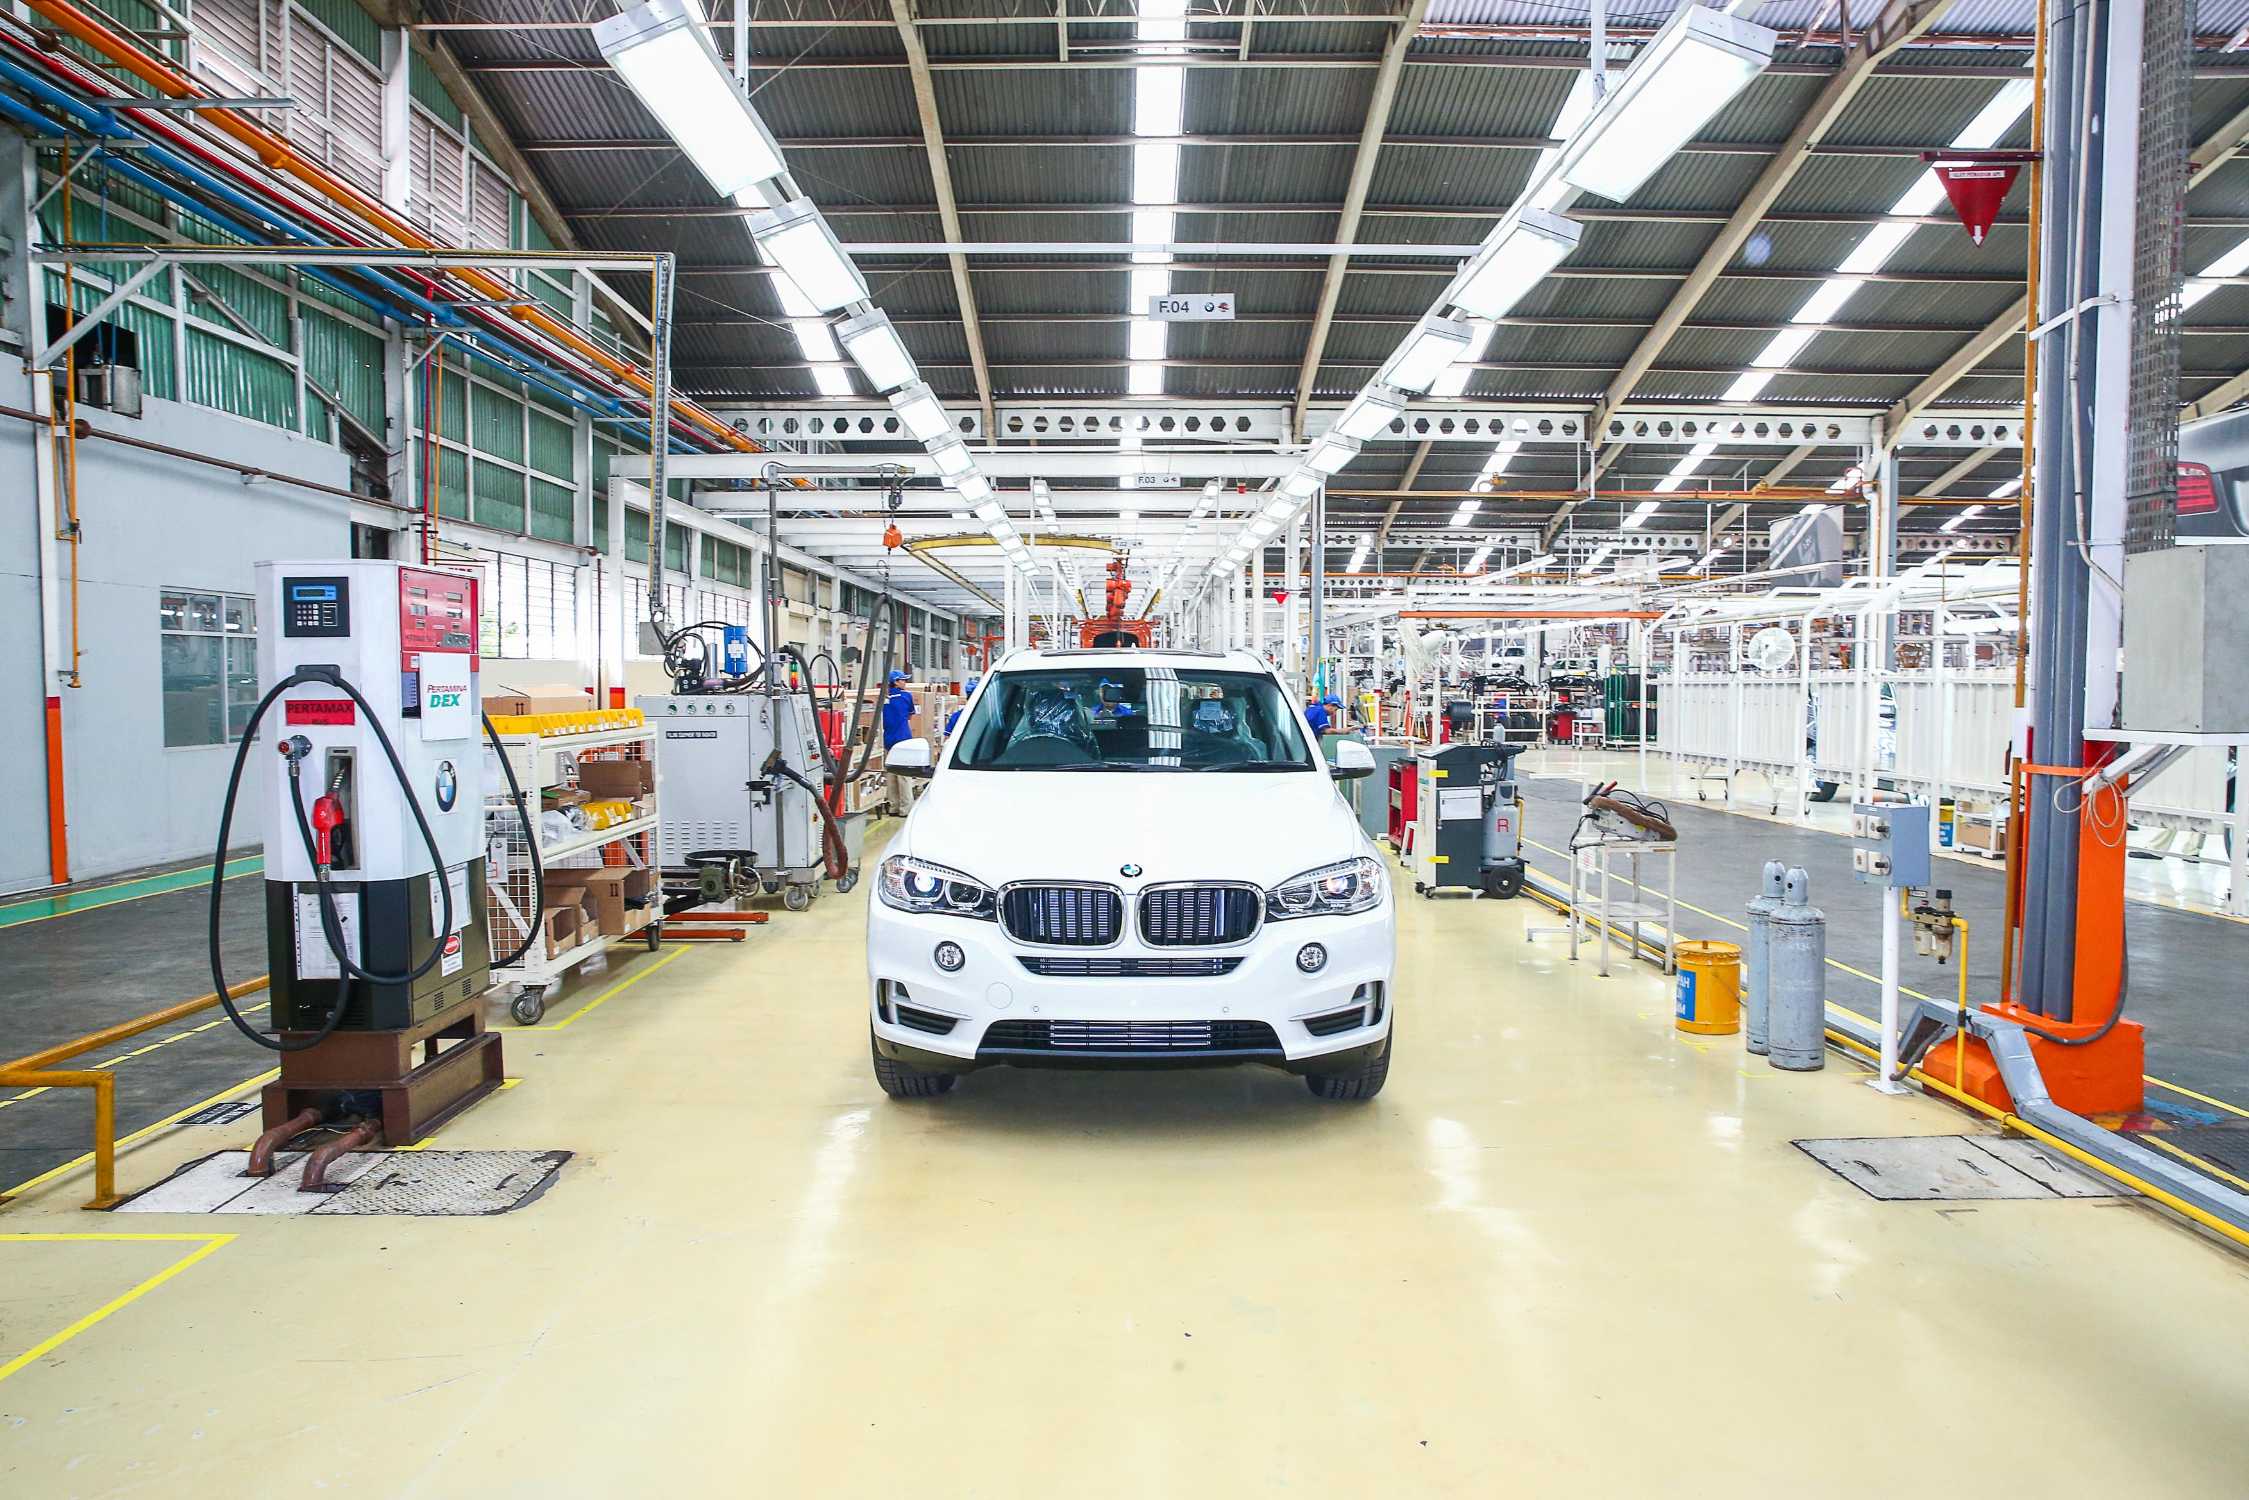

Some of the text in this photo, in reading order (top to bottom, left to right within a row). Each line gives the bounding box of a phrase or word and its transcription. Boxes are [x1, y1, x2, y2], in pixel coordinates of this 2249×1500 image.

[1159, 300, 1190, 313] F.04
[1138, 476, 1156, 484] F.03
[427, 684, 468, 693] PERTAMINA
[430, 693, 461, 708] DEX
[287, 703, 353, 714] PERTAMAX
